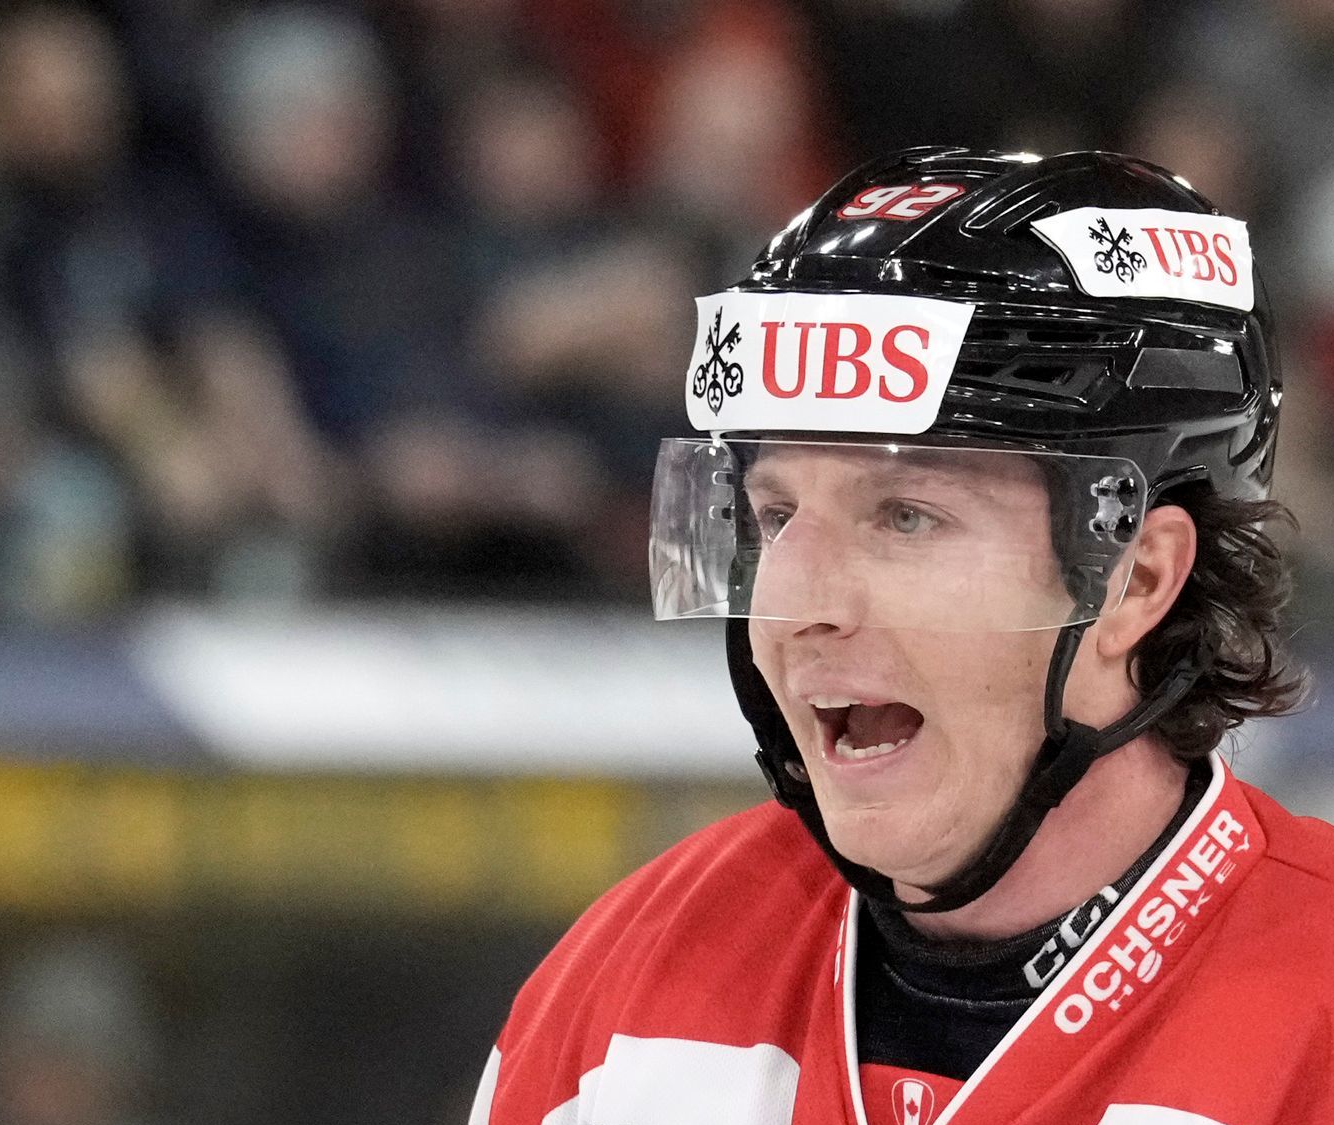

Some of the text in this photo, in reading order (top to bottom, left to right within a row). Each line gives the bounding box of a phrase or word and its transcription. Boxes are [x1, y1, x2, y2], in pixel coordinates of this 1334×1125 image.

[839, 183, 963, 221] 92
[1141, 227, 1239, 287] UBS
[759, 321, 930, 401] UBS
[1023, 885, 1120, 988] CC
[1054, 809, 1244, 1034] OCHSNER
